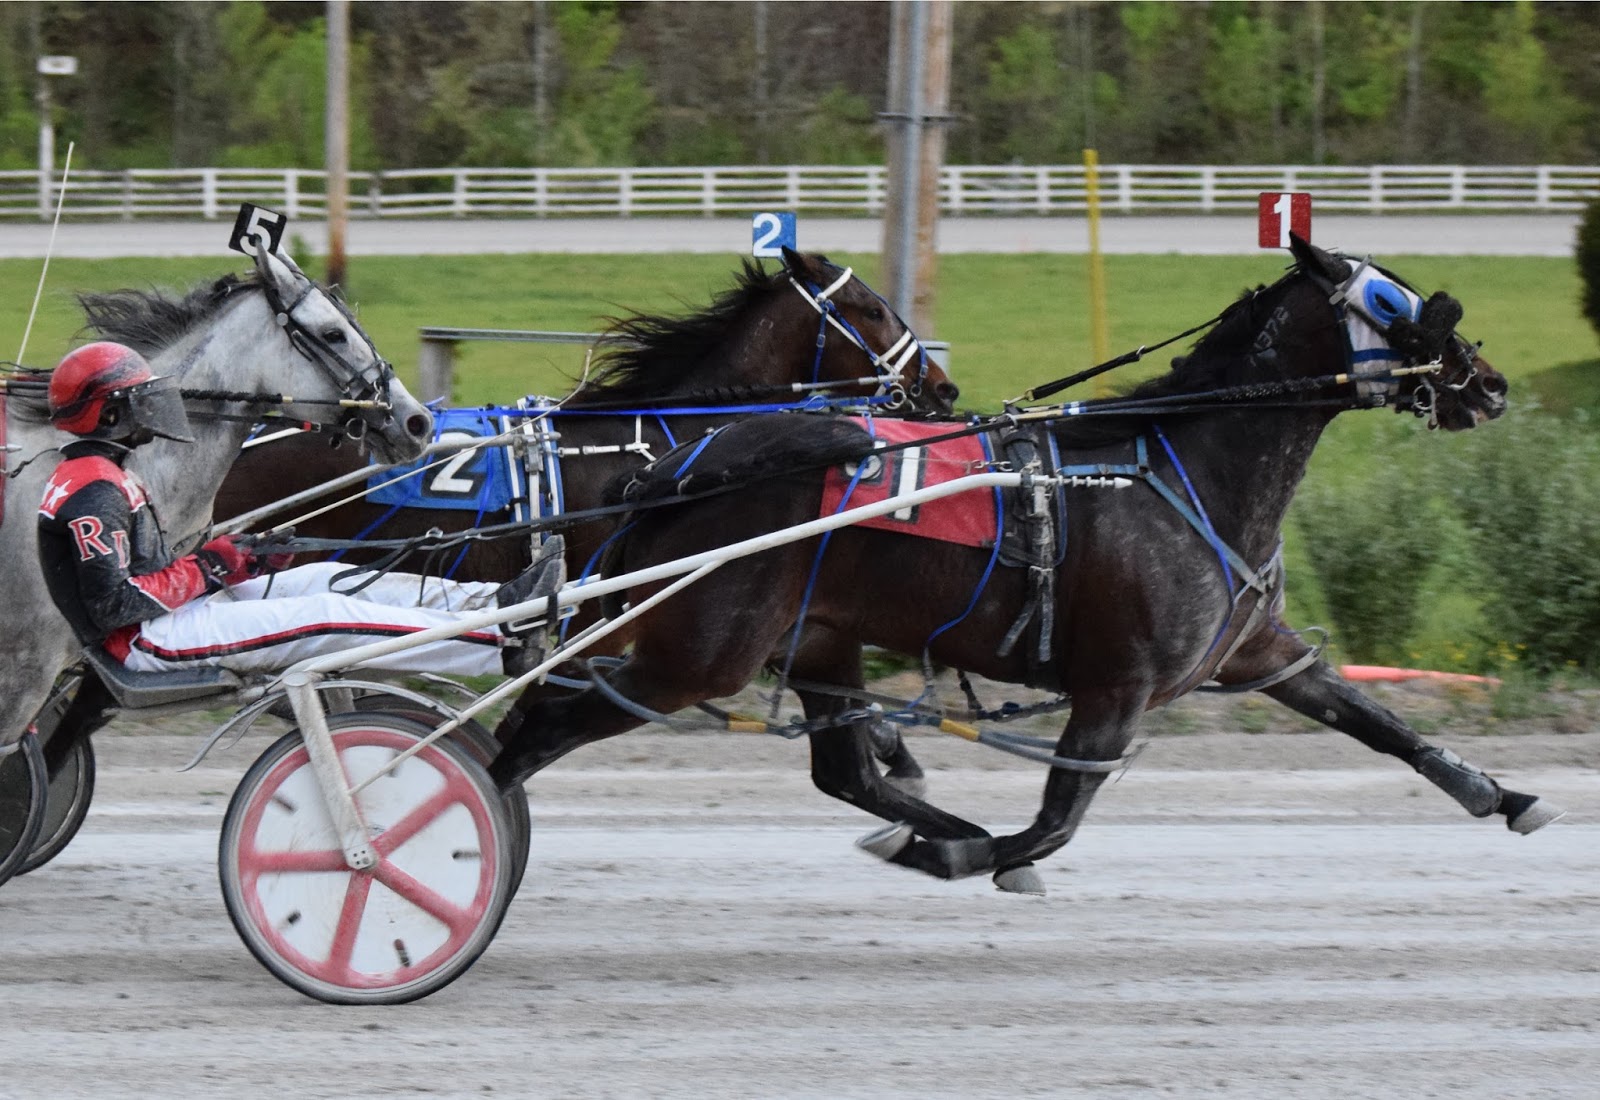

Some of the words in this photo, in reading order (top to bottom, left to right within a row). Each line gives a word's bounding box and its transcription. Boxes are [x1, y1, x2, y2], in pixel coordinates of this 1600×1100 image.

[240, 206, 279, 257] 5
[752, 212, 782, 257] 2
[1273, 194, 1292, 248] 1
[430, 431, 476, 493] 2
[894, 446, 921, 521] 1
